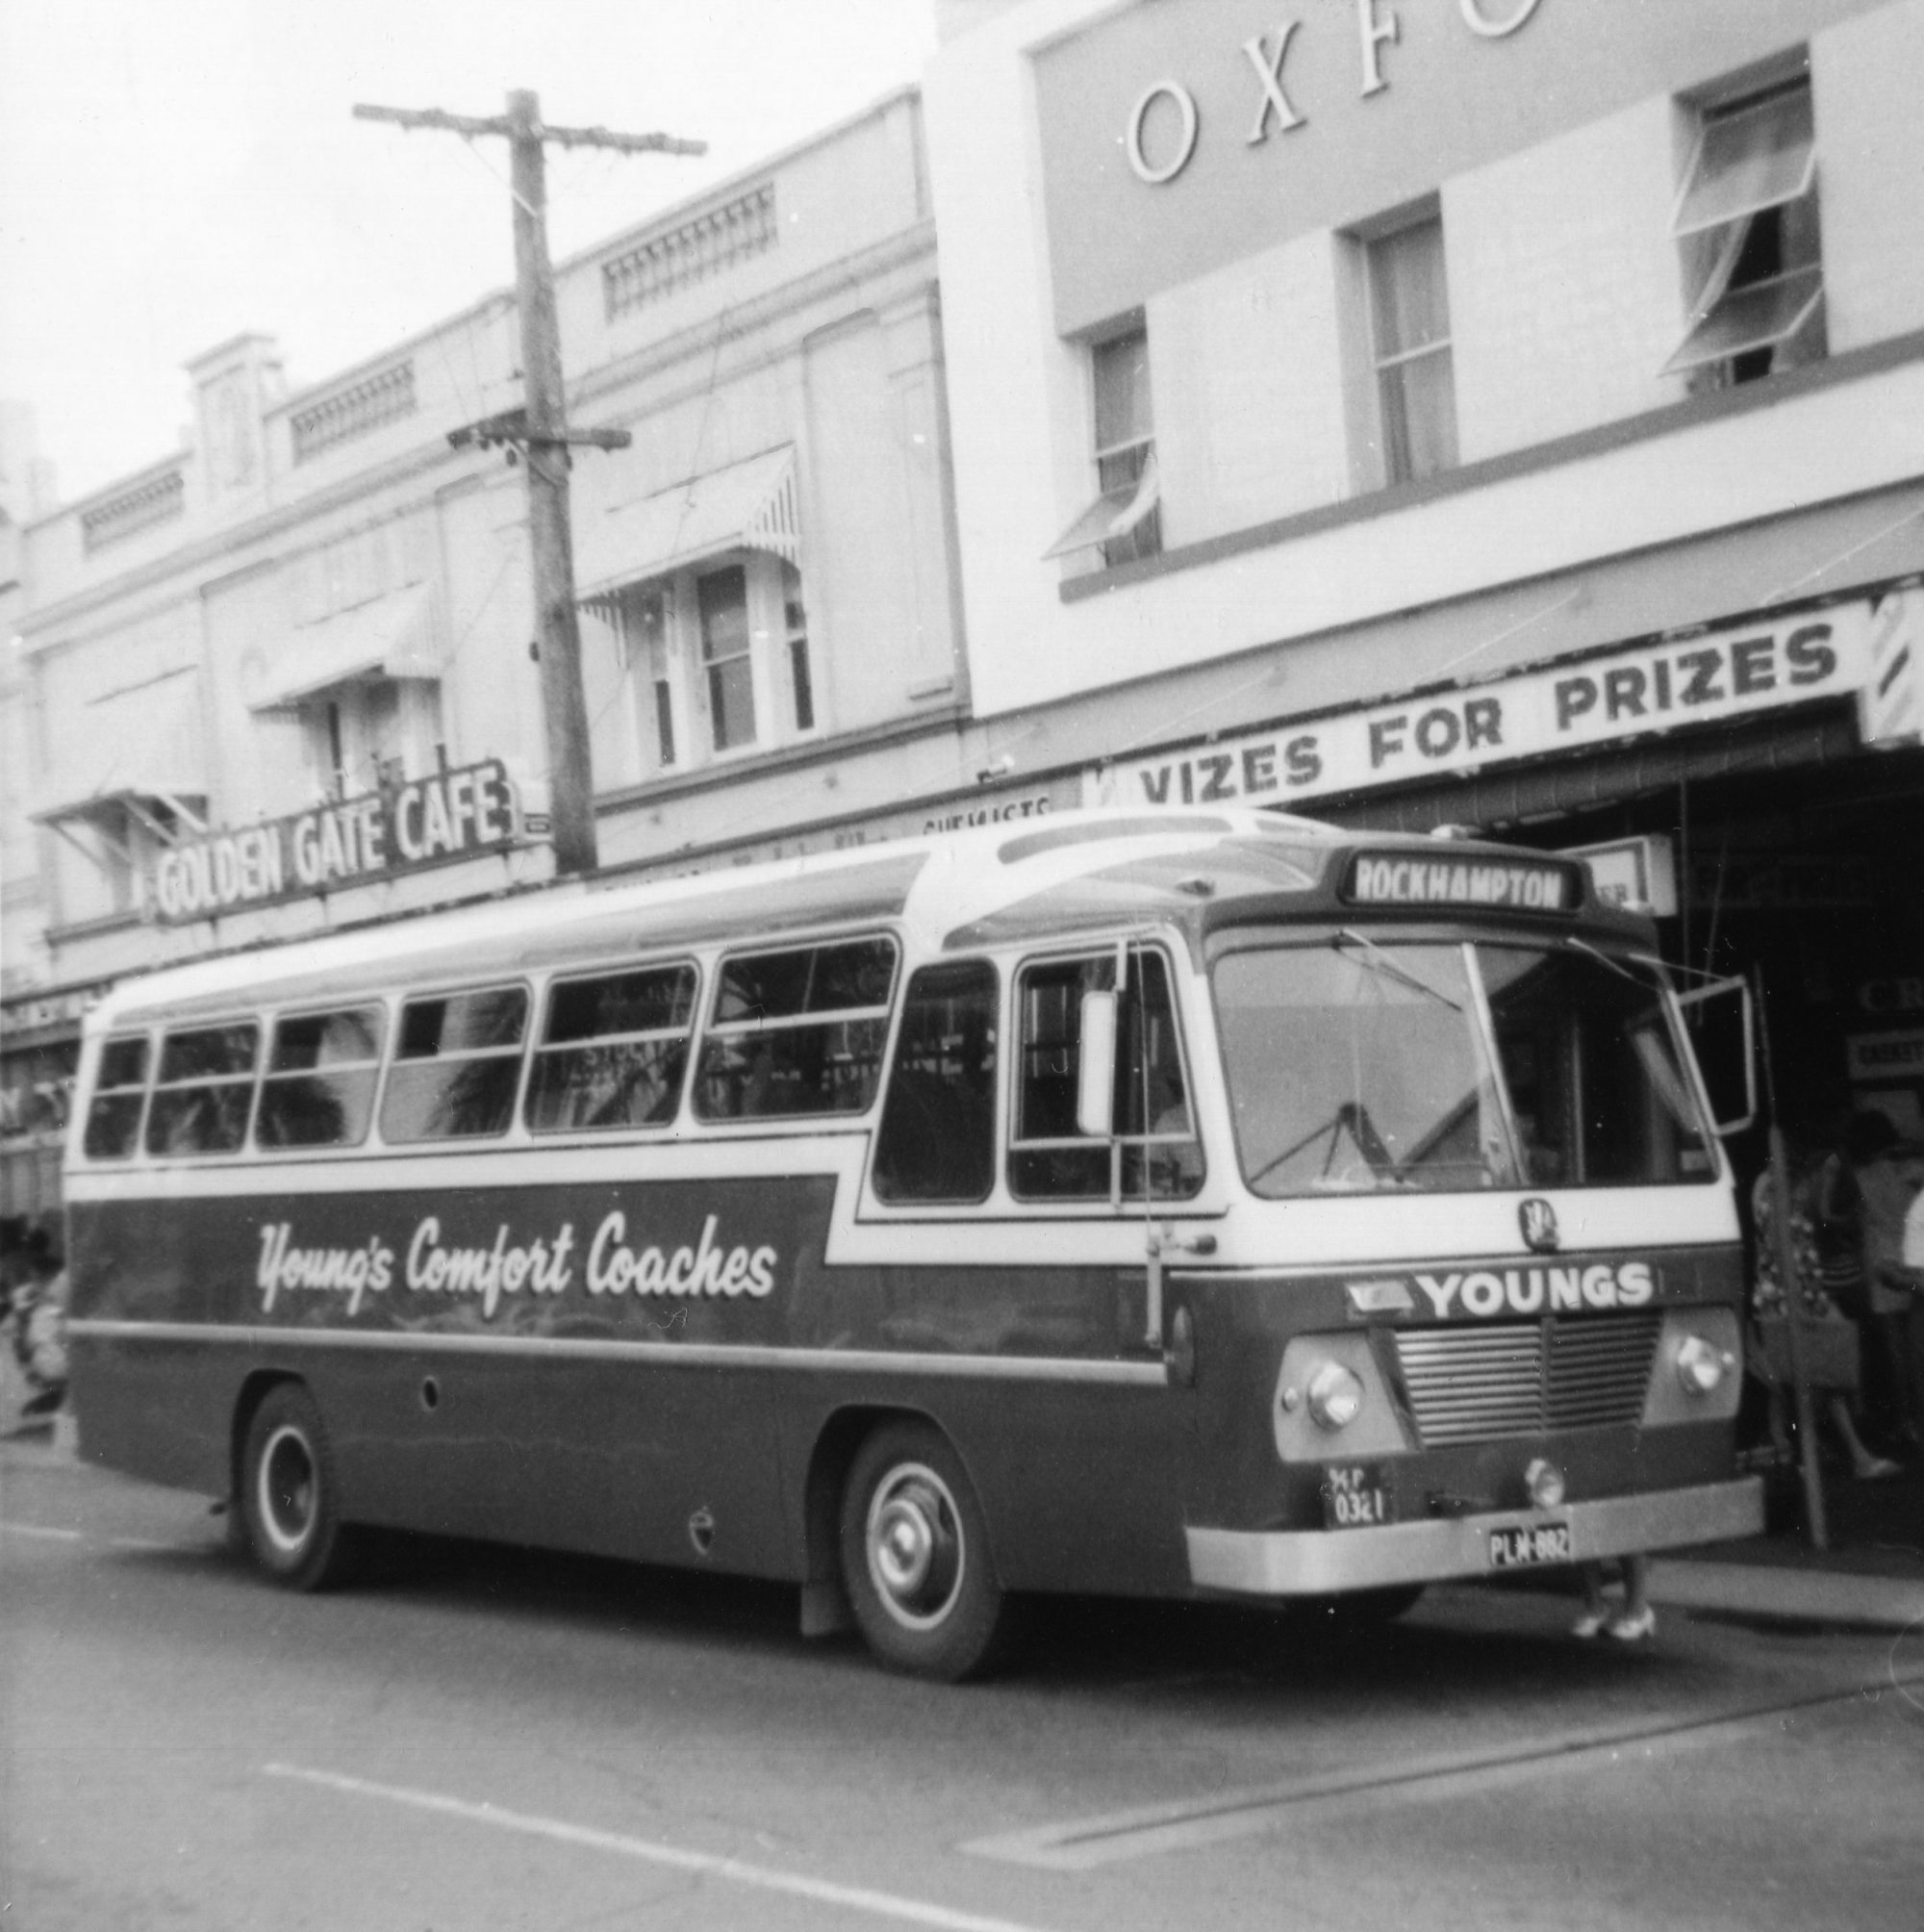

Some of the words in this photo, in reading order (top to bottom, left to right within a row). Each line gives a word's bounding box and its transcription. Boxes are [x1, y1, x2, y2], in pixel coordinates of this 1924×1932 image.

[1140, 735, 1322, 806] VIZES
[1368, 698, 1505, 770] FOR
[1556, 623, 1837, 732] PRIZES
[159, 833, 282, 915] GOLDEN
[294, 800, 385, 884] GATE
[396, 769, 501, 859] CAFE
[1356, 858, 1562, 908] ROCKHAMPTON
[257, 1221, 393, 1315] Young's
[405, 1216, 573, 1316] Comfort
[585, 1209, 777, 1297] Coaches
[1414, 1261, 1654, 1318] YOUNGS
[1334, 1488, 1383, 1524] 0321
